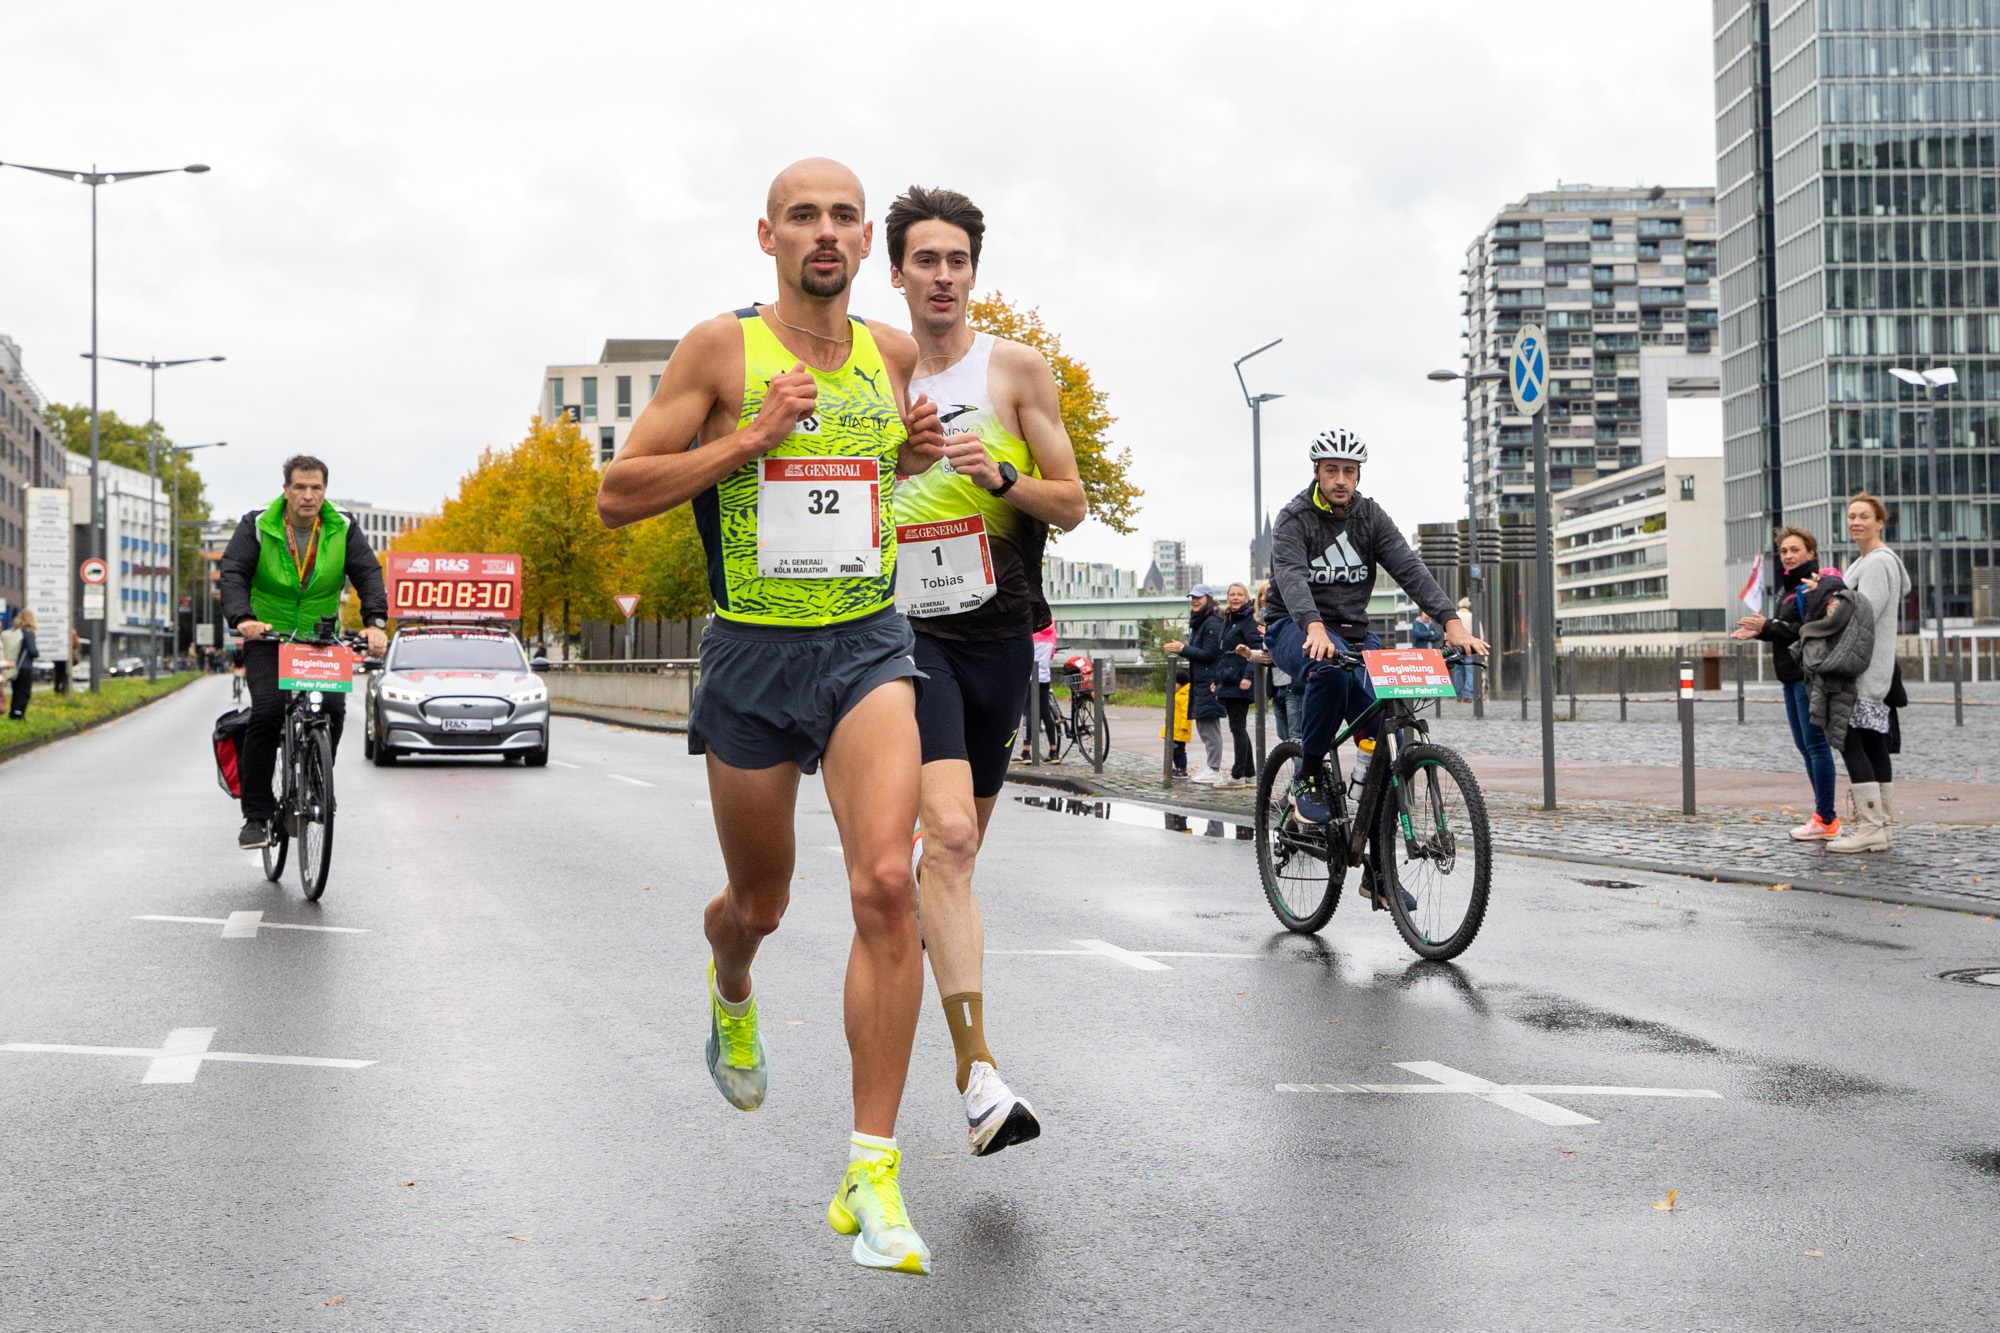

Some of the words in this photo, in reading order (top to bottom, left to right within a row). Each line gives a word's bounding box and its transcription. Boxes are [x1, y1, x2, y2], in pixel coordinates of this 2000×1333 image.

[839, 415, 889, 430] VIACTIV
[804, 463, 860, 477] GENERALI
[808, 489, 840, 515] 32
[918, 521, 969, 539] GENERALI
[931, 545, 943, 567] 1
[435, 558, 470, 572] R&S
[791, 558, 824, 566] GENERALI
[773, 565, 792, 574] KÖLN
[793, 566, 828, 574] MARATHON
[840, 564, 864, 573] PUMA
[1308, 565, 1369, 584] adidas
[920, 574, 965, 589] Tobias
[396, 580, 512, 609] 00:08:30
[919, 600, 945, 609] GENERALI
[959, 599, 981, 609] PUMA
[921, 605, 951, 615] MARATHON
[461, 634, 514, 643] FAHRZEUG
[292, 658, 340, 670] Begleitung
[1382, 664, 1434, 674] Begleitung
[1400, 675, 1423, 683] Elite
[296, 680, 314, 689] Freie
[1415, 687, 1438, 695] Fahrt!
[445, 720, 468, 729] R&S
